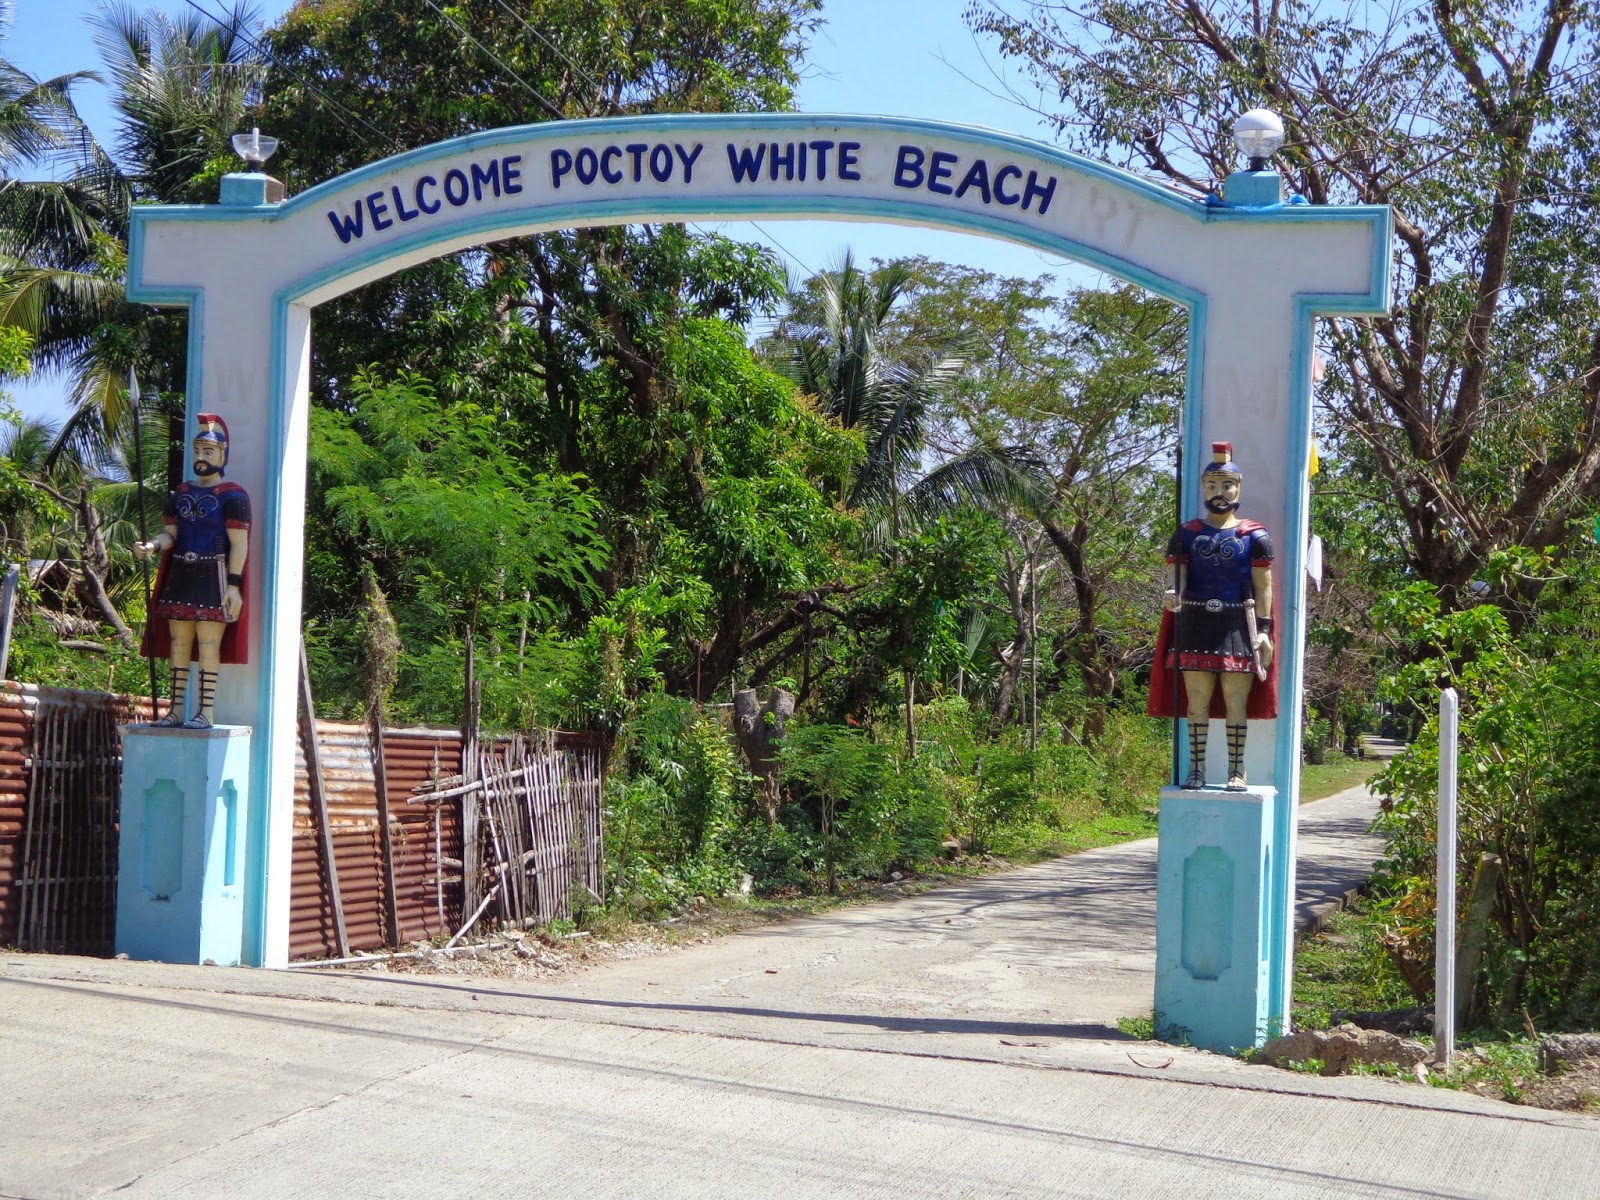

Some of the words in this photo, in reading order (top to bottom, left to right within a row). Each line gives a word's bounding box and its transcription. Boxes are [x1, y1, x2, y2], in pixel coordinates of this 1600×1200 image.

[327, 154, 524, 245] WELCOME
[550, 142, 704, 190] POCTOY
[726, 141, 862, 184] WHITE
[893, 145, 1058, 216] BEACH
